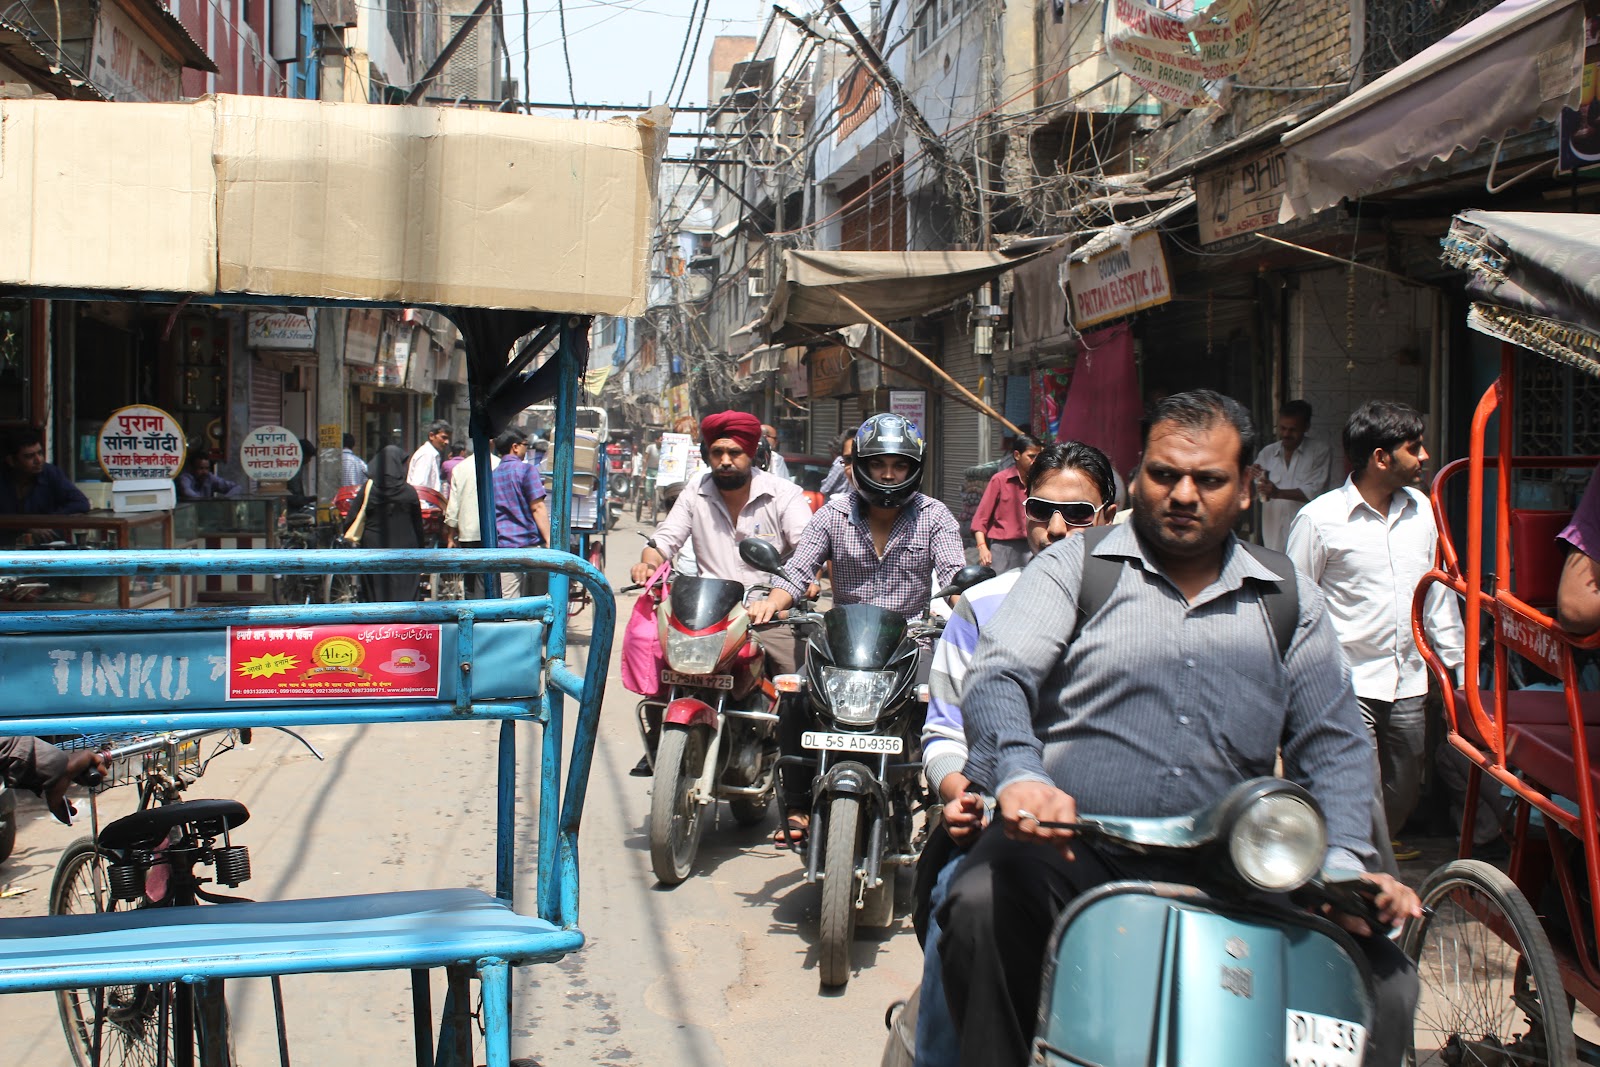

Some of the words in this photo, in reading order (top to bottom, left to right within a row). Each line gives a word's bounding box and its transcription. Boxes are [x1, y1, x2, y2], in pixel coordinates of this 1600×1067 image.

[1097, 250, 1131, 280] GODOWN
[1077, 284, 1112, 318] PRITAM
[117, 415, 165, 436] पुराना
[254, 433, 287, 445] पुराना
[243, 444, 270, 457] सोना
[320, 647, 353, 664] Altaj
[48, 649, 191, 701] TINKU
[804, 734, 819, 747] DL
